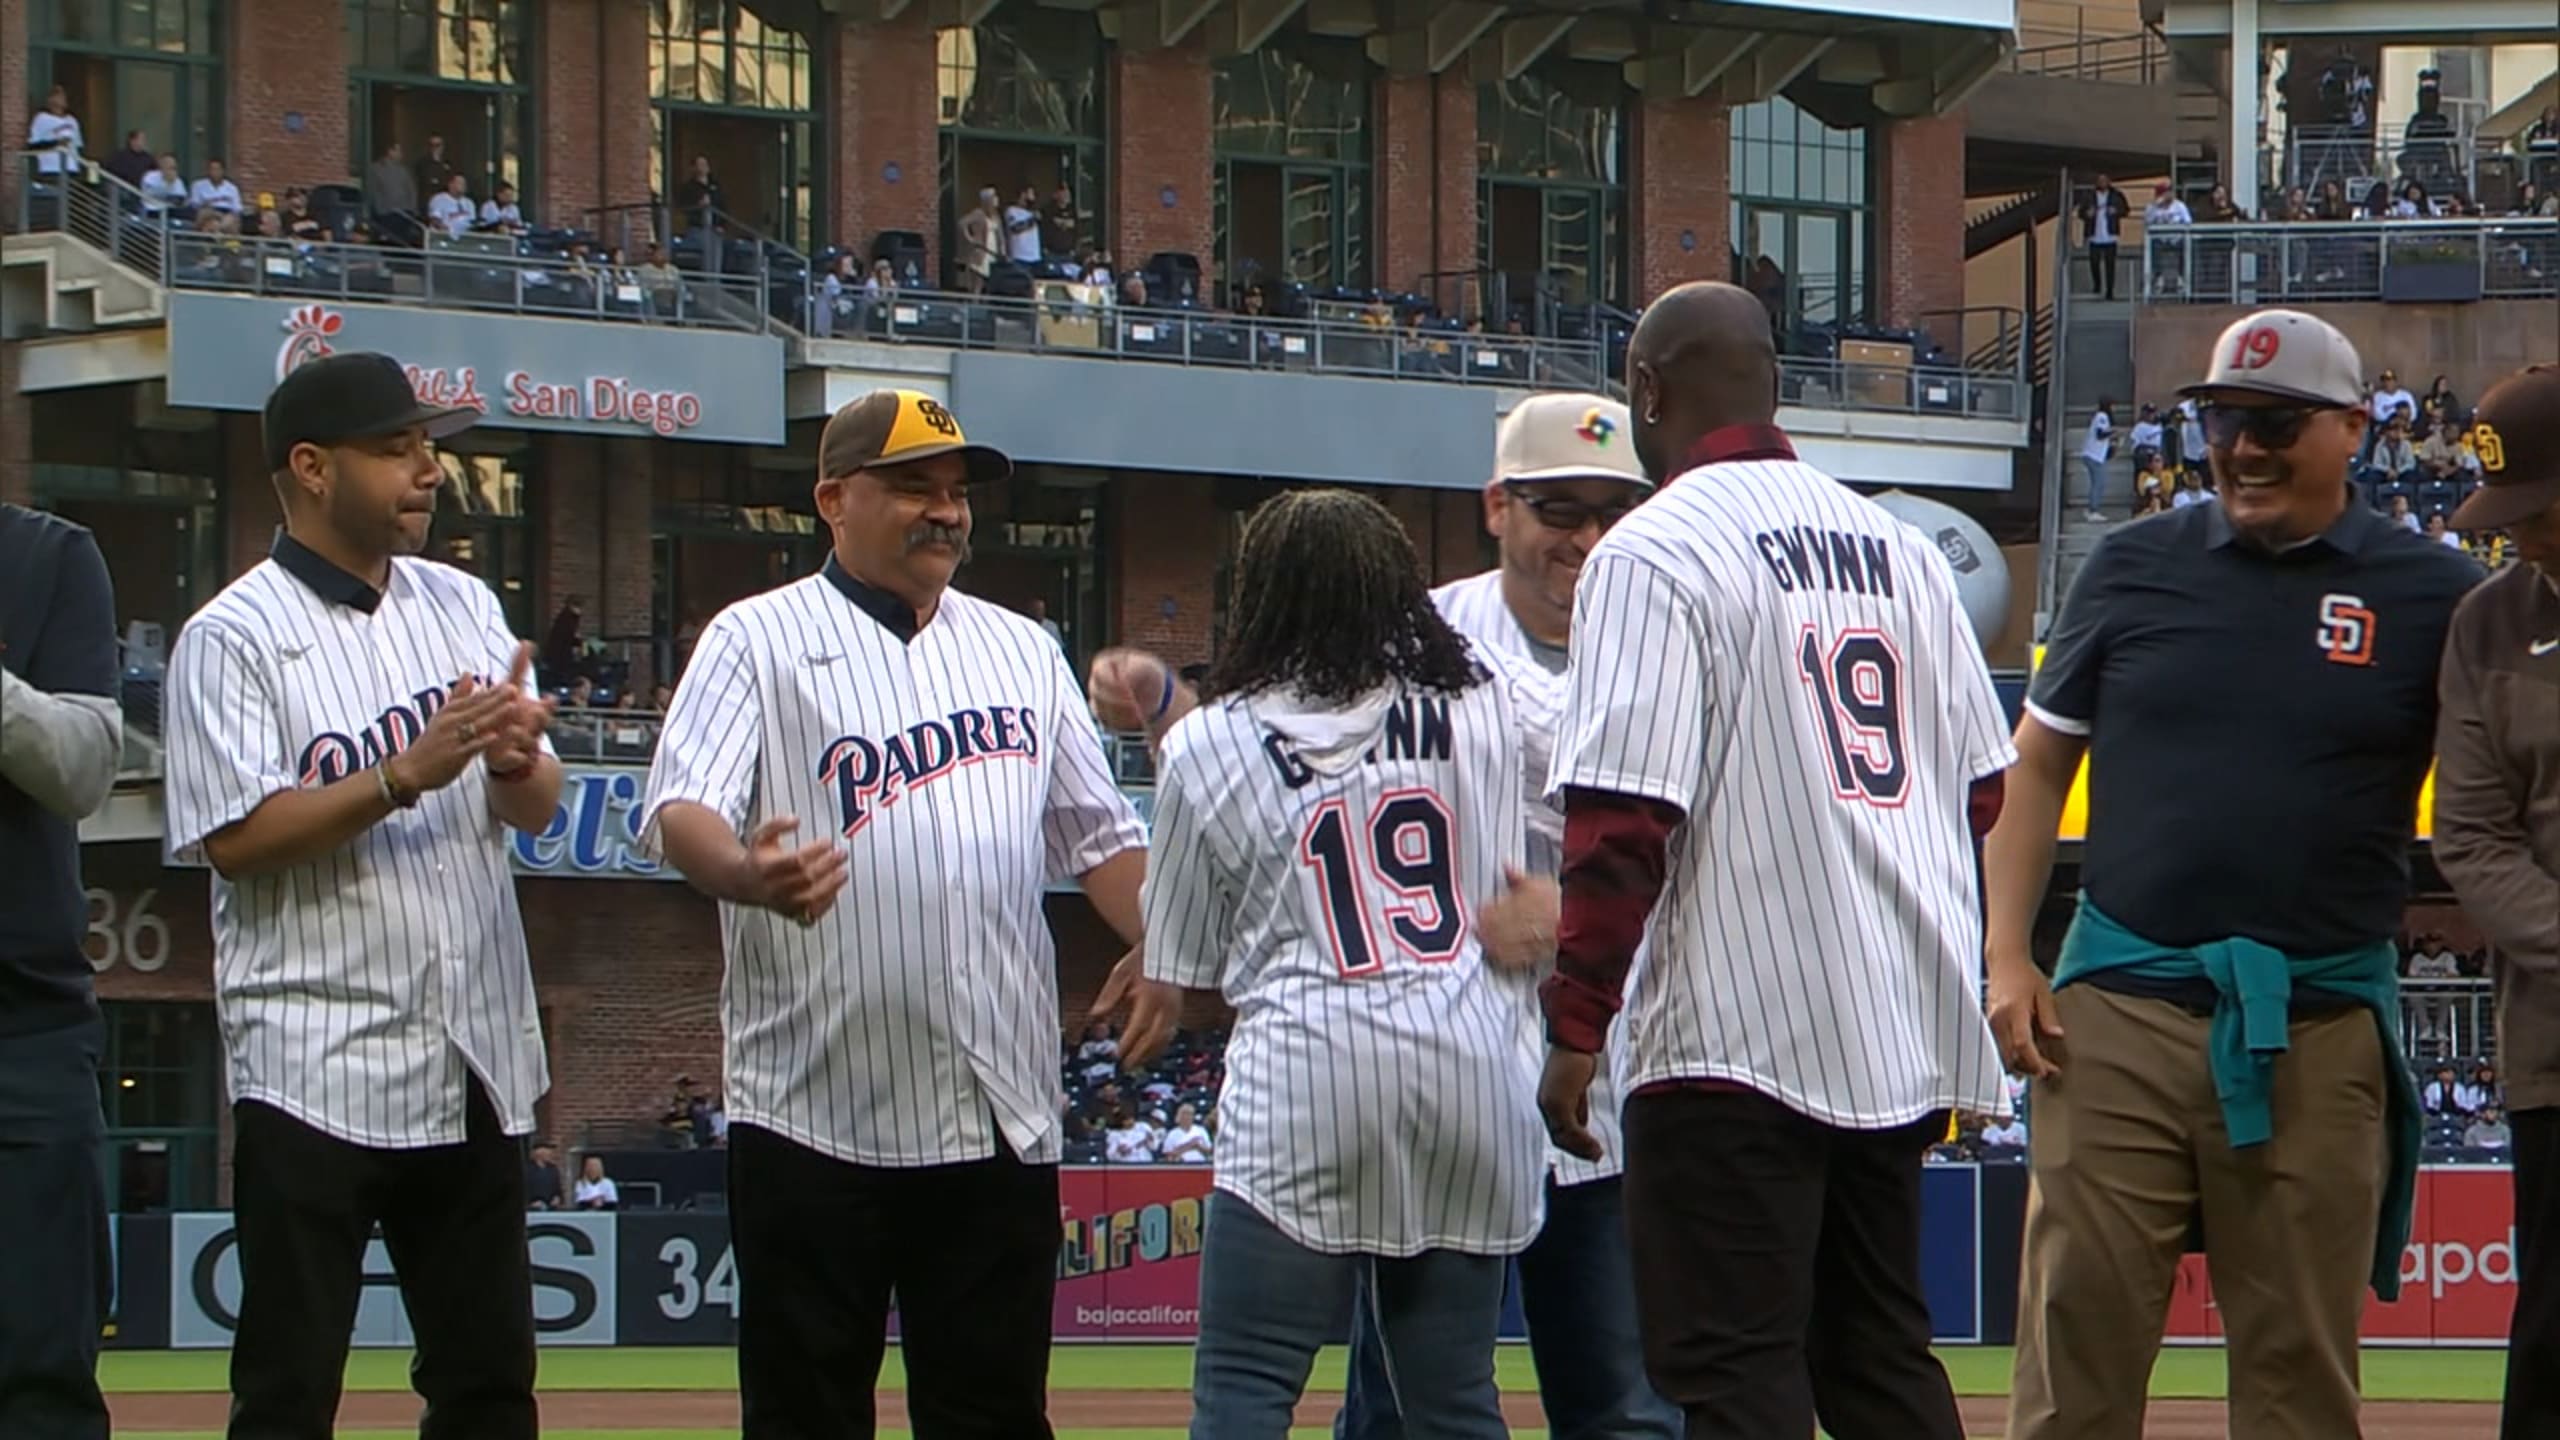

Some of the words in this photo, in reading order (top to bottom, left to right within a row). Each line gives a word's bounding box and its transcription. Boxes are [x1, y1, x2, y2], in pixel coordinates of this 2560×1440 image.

[2228, 326, 2279, 371] 19
[507, 371, 579, 418] San
[587, 376, 701, 436] Diego
[1756, 526, 1893, 598] GWYNN
[2317, 593, 2376, 665] SD
[1263, 695, 1450, 789] GNN
[1796, 623, 1912, 808] 19
[817, 705, 1038, 838] PADRES
[1301, 787, 1468, 978] 19
[1056, 1197, 1203, 1279] LIFOR
